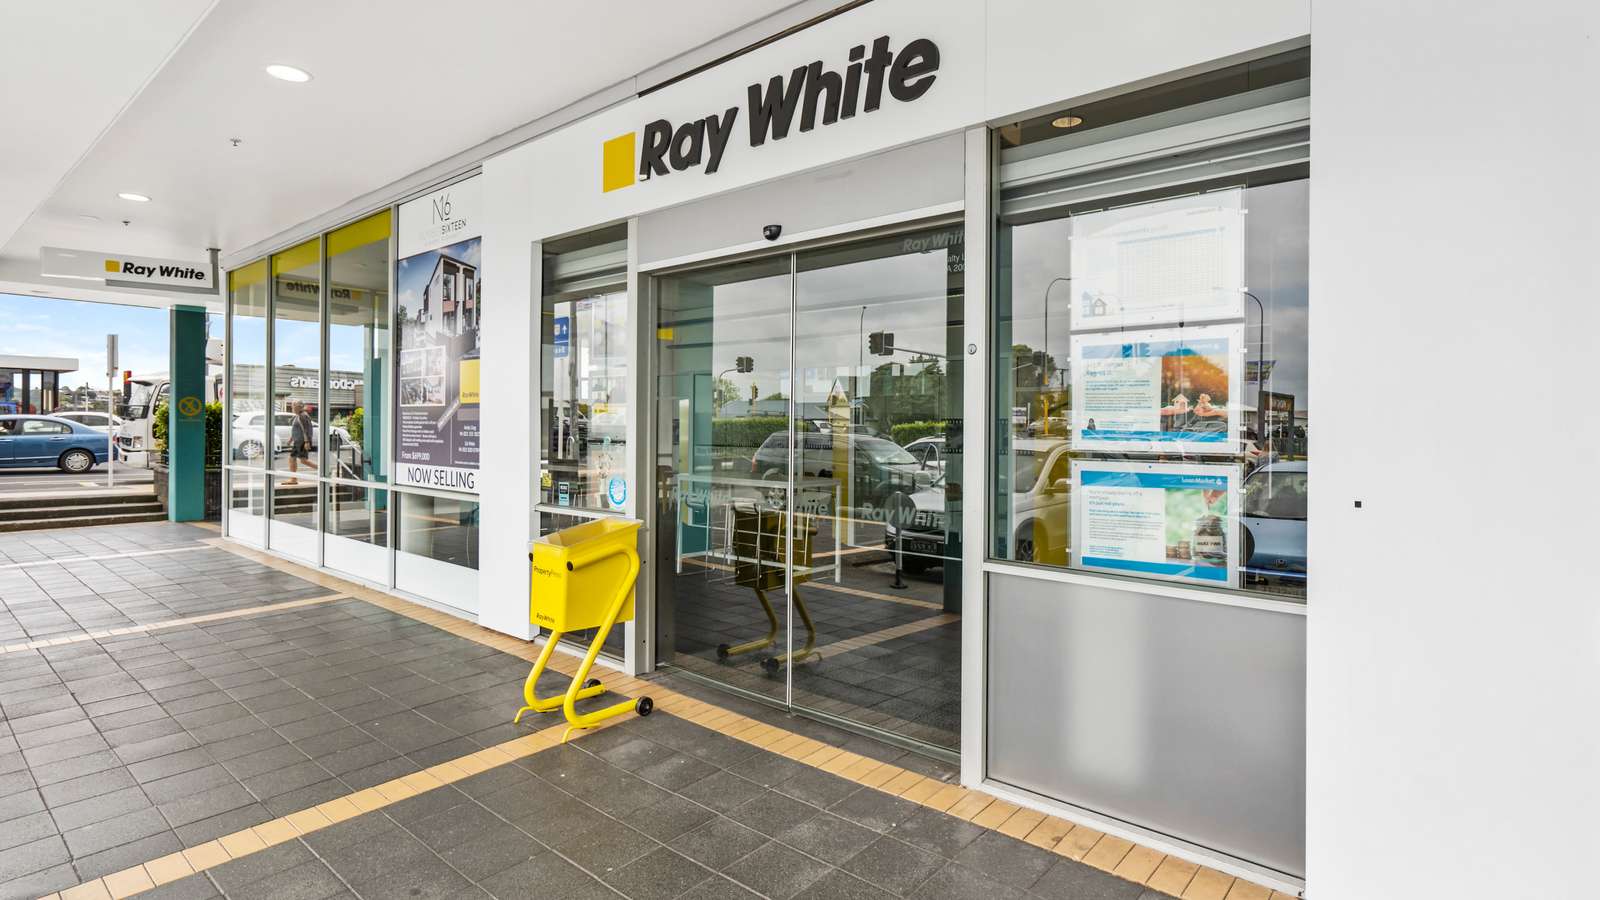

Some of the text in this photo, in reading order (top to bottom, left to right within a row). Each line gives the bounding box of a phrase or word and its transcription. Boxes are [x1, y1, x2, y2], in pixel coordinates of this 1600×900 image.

[639, 35, 940, 182] Ray White
[441, 219, 467, 235] SIXTEEN
[903, 229, 965, 251] Ray Whit
[122, 262, 156, 278] Ray
[407, 466, 475, 489] NOW SELLING
[862, 502, 896, 523] Ray
